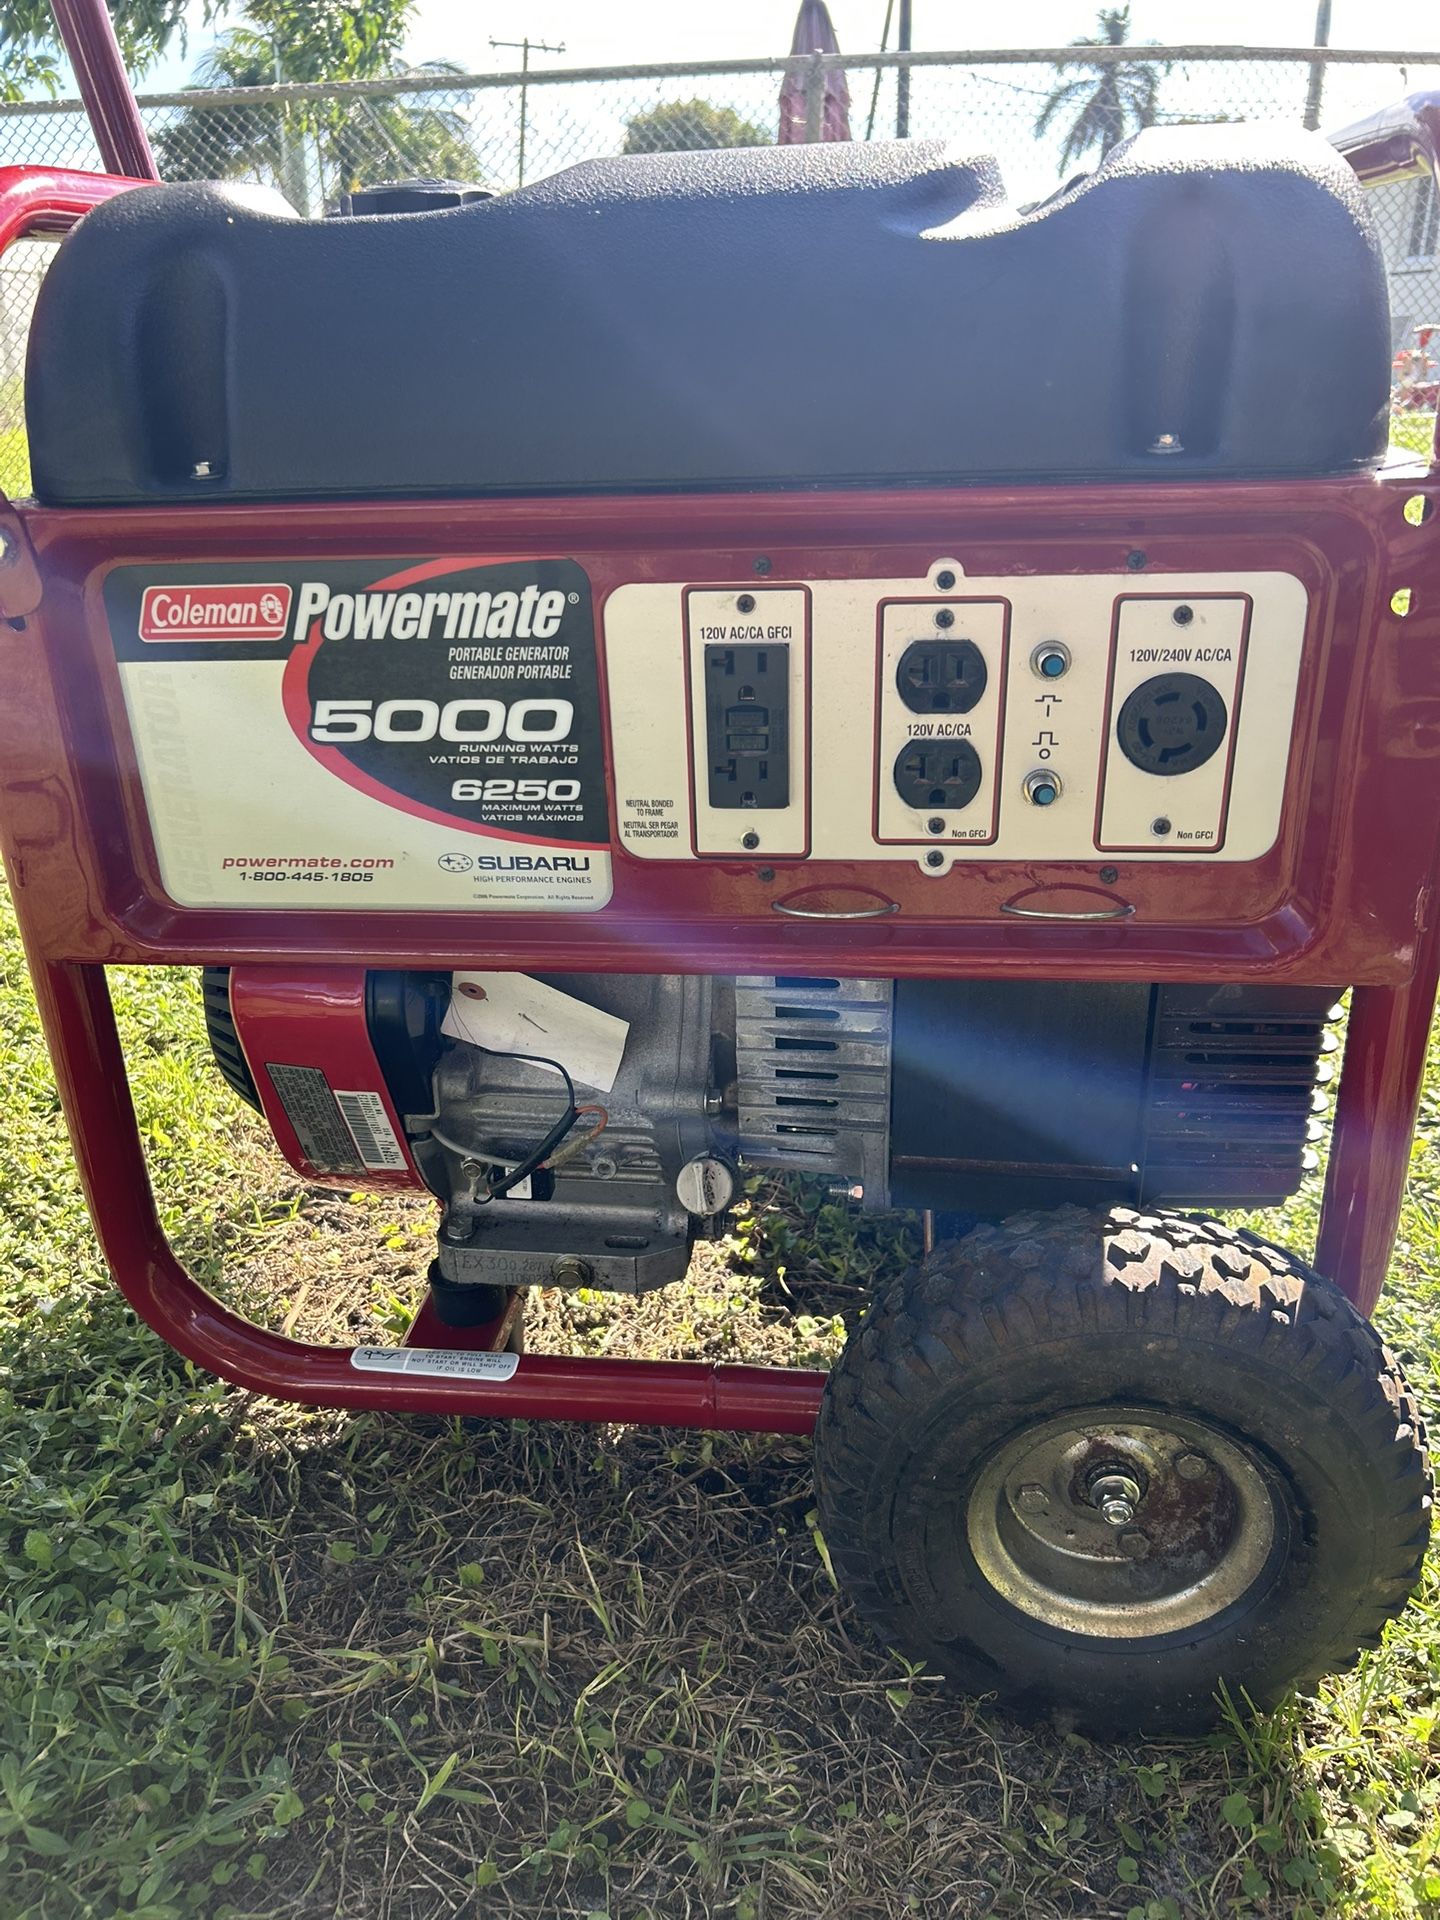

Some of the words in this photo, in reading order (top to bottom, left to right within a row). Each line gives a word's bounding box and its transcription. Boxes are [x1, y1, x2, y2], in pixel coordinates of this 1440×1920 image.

[151, 594, 257, 628] Coleman
[700, 627, 726, 640] 120V
[730, 626, 764, 640] AC/CA
[767, 626, 792, 639] GFCI
[448, 646, 502, 662] PORTABLE
[506, 646, 570, 662] GENERATOR
[1130, 649, 1192, 662] 120V/240V
[1194, 648, 1232, 662] AC/CA
[449, 665, 515, 681] GENERADOR
[517, 664, 572, 680] PORTABLE
[310, 698, 574, 744] 5000
[906, 724, 935, 736] 120V
[936, 724, 972, 736] AC/CA
[459, 744, 526, 754] RUNNING
[529, 744, 578, 754] WATTS
[428, 756, 481, 764] VATIOS
[486, 756, 505, 764] DE
[510, 755, 578, 765] TRABAJO
[450, 778, 582, 802] 6250
[625, 800, 650, 808] NEUTRAL
[650, 800, 674, 808] BONDED
[526, 812, 584, 822] MÁXIMOS
[636, 808, 644, 816] TO
[644, 808, 664, 816] FRAME
[623, 821, 648, 830] NEUTRAL
[648, 821, 660, 830] SER
[660, 821, 679, 830] PEGAR
[624, 830, 632, 838] AL
[632, 830, 679, 838] TRANSPORTADOR
[952, 829, 967, 839] Non
[968, 829, 987, 839] GFCI
[1176, 830, 1193, 840] Non
[1194, 830, 1214, 840] GFCI
[222, 856, 394, 870] powermate.com
[478, 856, 590, 872] SUBARU
[239, 871, 374, 882] 1-800-445-1805
[473, 876, 494, 884] HIGH
[495, 876, 554, 884] PERFORMANCE
[556, 876, 592, 884] ENGINES
